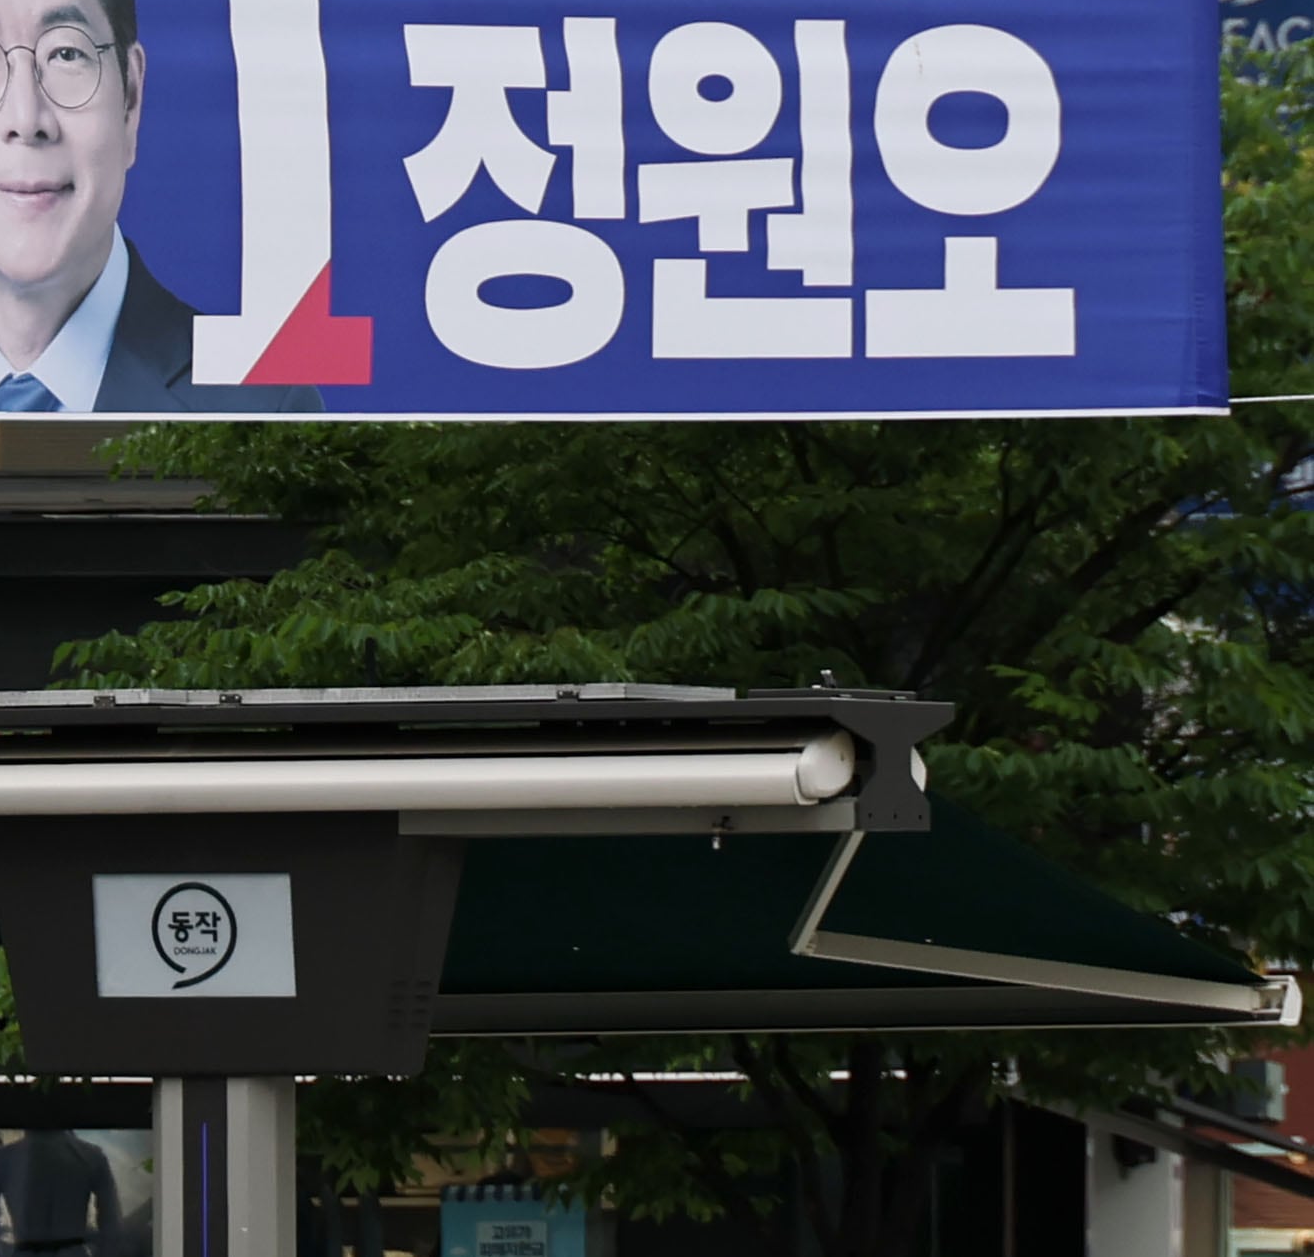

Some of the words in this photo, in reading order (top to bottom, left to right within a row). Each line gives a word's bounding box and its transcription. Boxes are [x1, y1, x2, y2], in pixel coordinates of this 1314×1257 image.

[402, 17, 1075, 369] 정원오
[168, 911, 222, 944] 동작
[173, 946, 217, 956] DONGJAK
